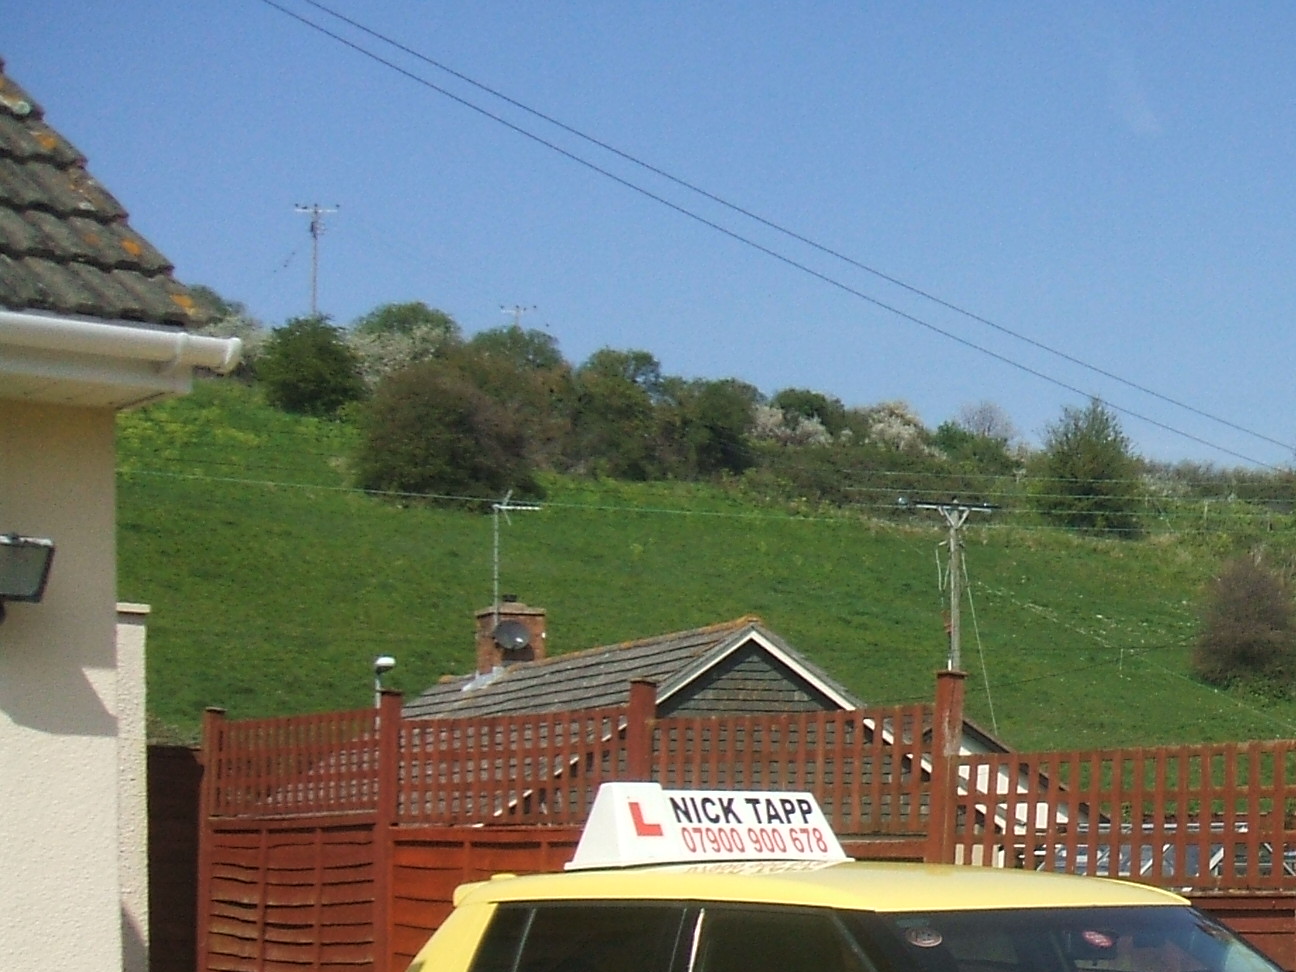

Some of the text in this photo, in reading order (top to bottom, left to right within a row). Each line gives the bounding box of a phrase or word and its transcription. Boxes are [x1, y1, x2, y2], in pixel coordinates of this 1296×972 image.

[628, 802, 664, 836] L
[670, 797, 813, 824] NICK TAPP
[681, 827, 828, 853] 07900 900 678
